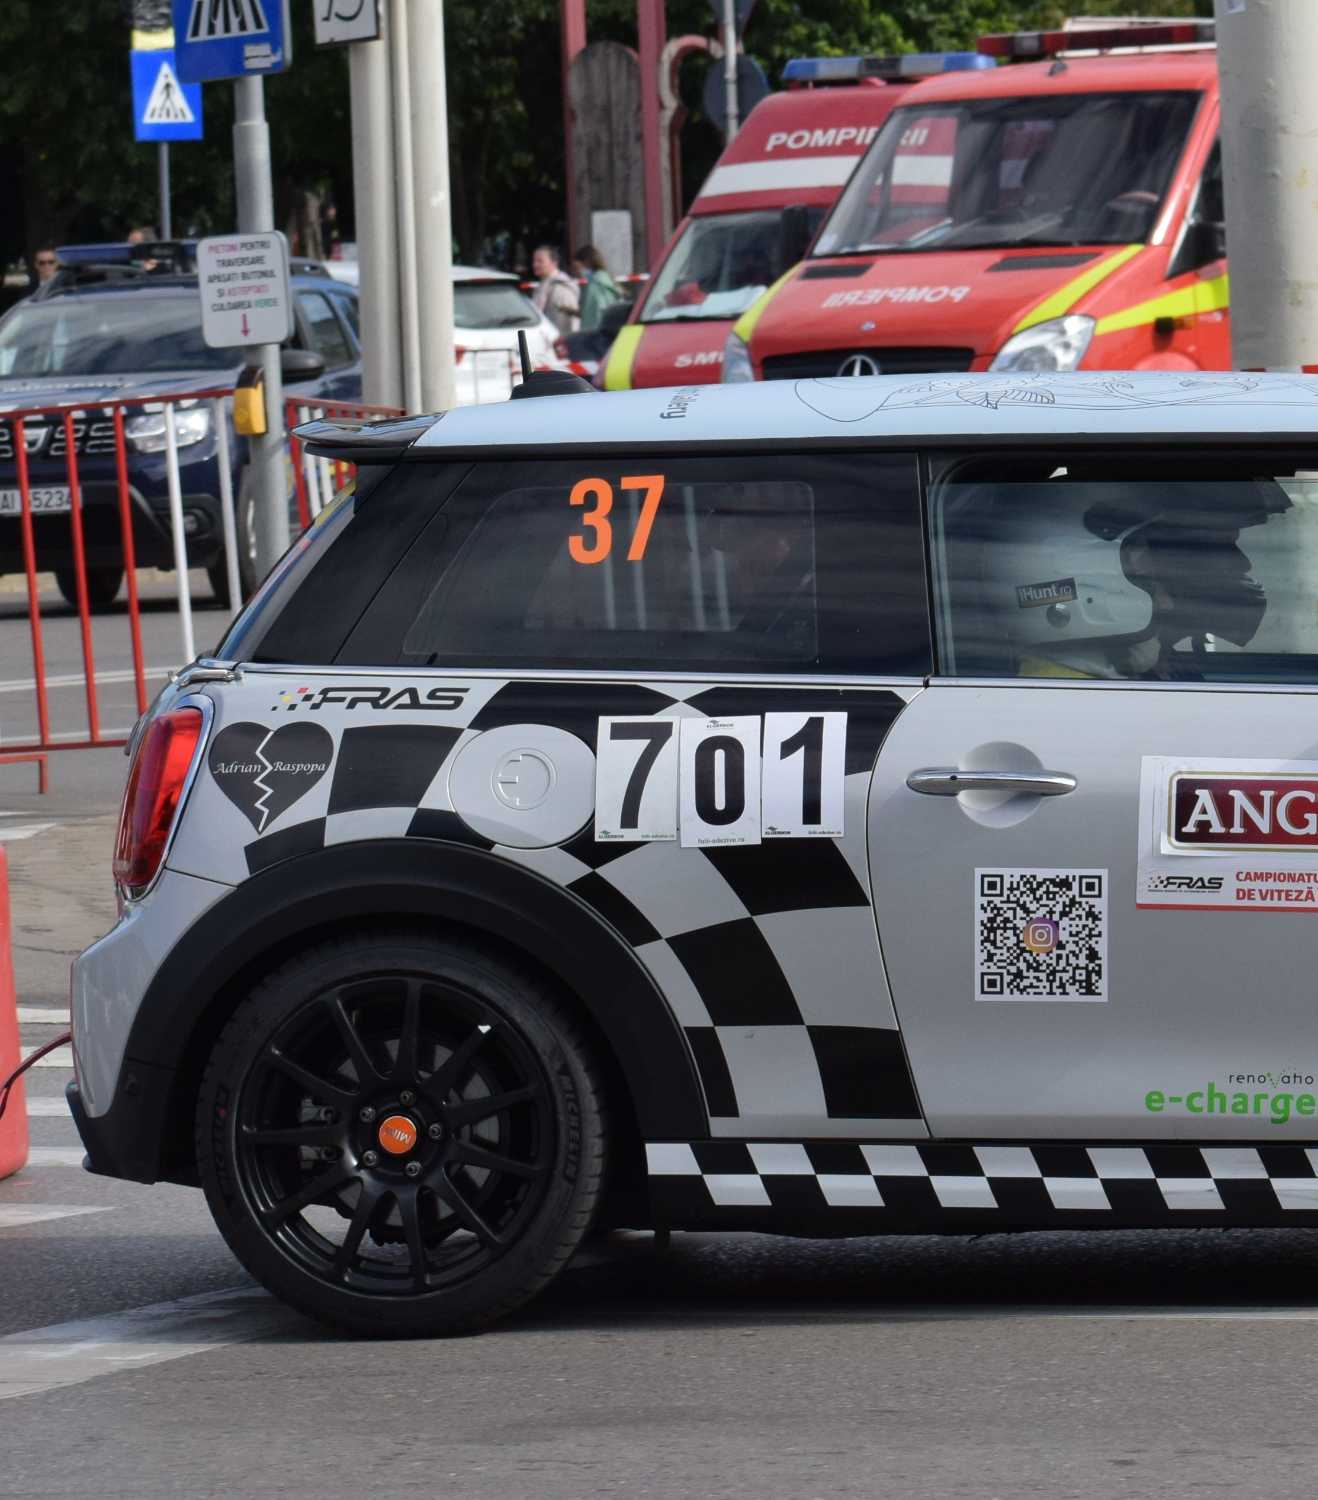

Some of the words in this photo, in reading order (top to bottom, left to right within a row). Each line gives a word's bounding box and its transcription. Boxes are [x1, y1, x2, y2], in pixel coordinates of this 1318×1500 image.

[766, 126, 928, 152] POMPIII
[569, 475, 666, 565] 37
[311, 686, 471, 711] FRAS
[212, 760, 262, 776] Adrian
[272, 760, 326, 776] Raspopa
[1162, 875, 1225, 890] FRAS
[1235, 888, 1256, 901] DE
[1258, 886, 1316, 903] VITEZĂ
[1144, 1081, 1317, 1125] e-charge
